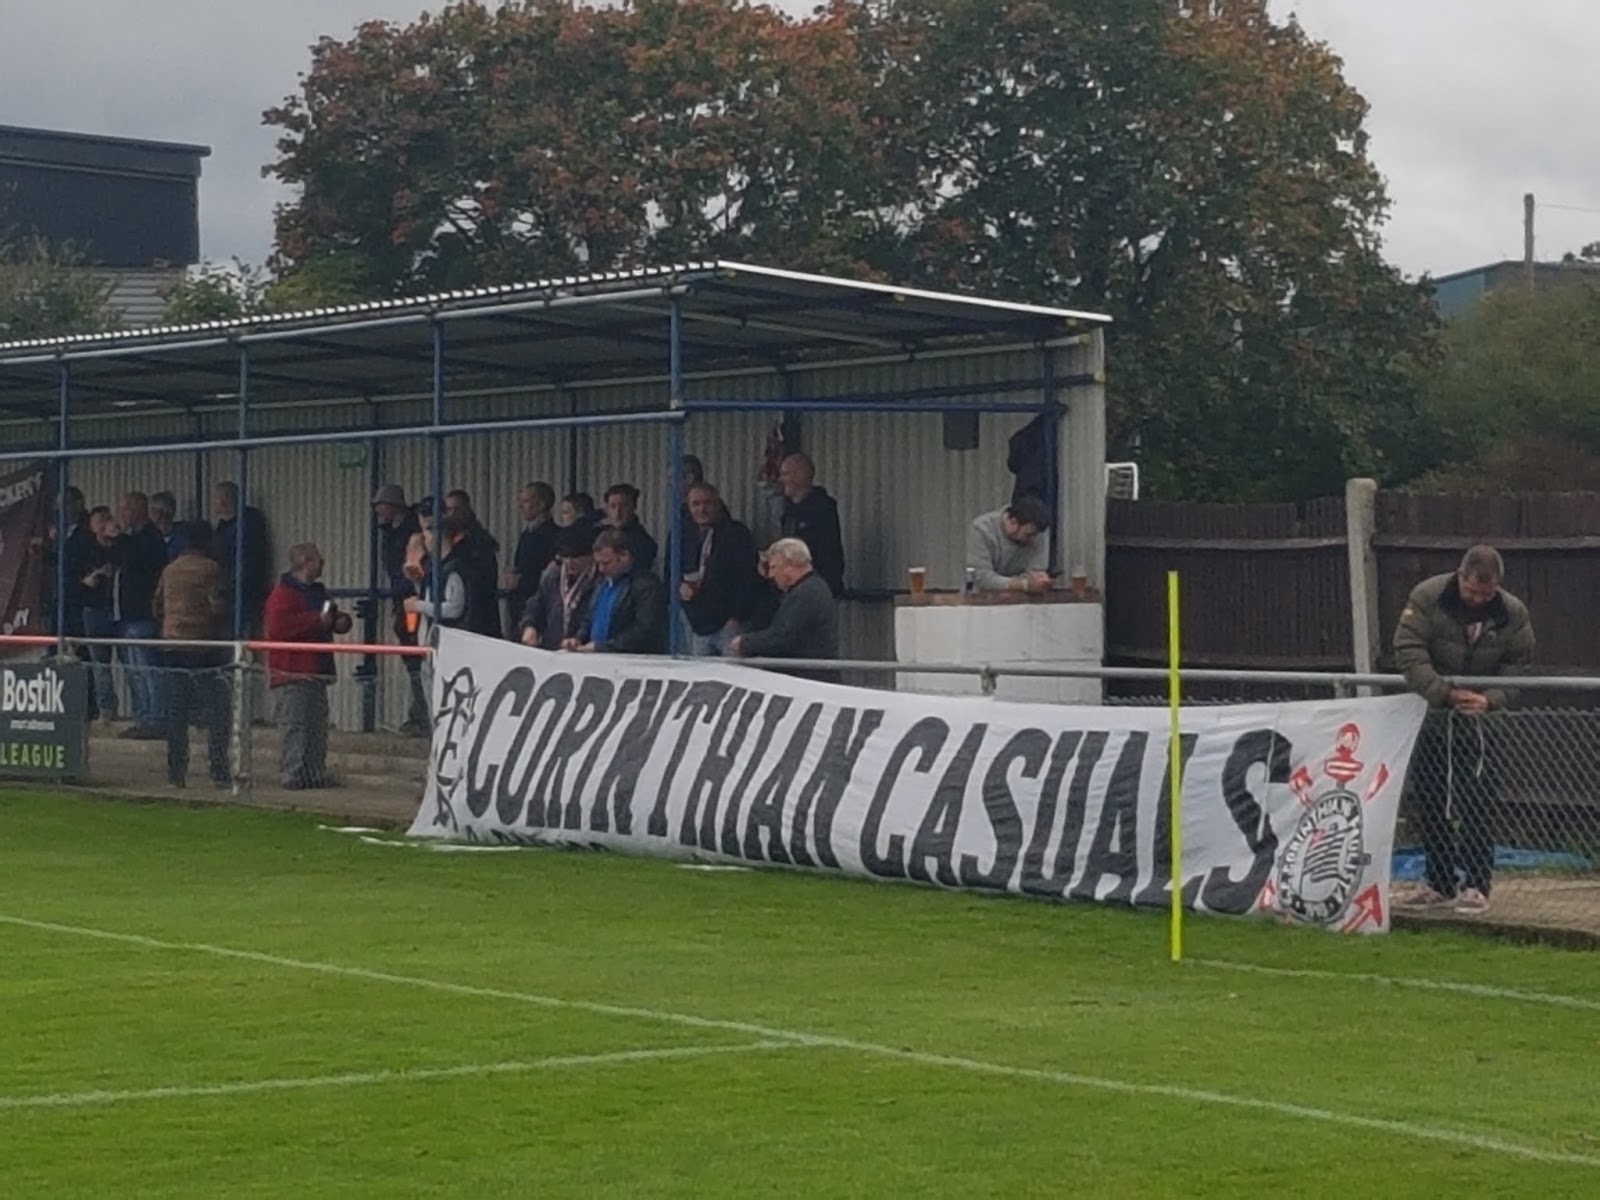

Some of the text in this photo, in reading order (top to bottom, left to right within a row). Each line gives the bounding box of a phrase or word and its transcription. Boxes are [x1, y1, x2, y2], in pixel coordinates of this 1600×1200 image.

[2, 667, 65, 713] Bostik
[0, 742, 65, 768] LEAGUE
[465, 666, 885, 869] CORINTHIAN
[860, 716, 1292, 915] CASUALS
